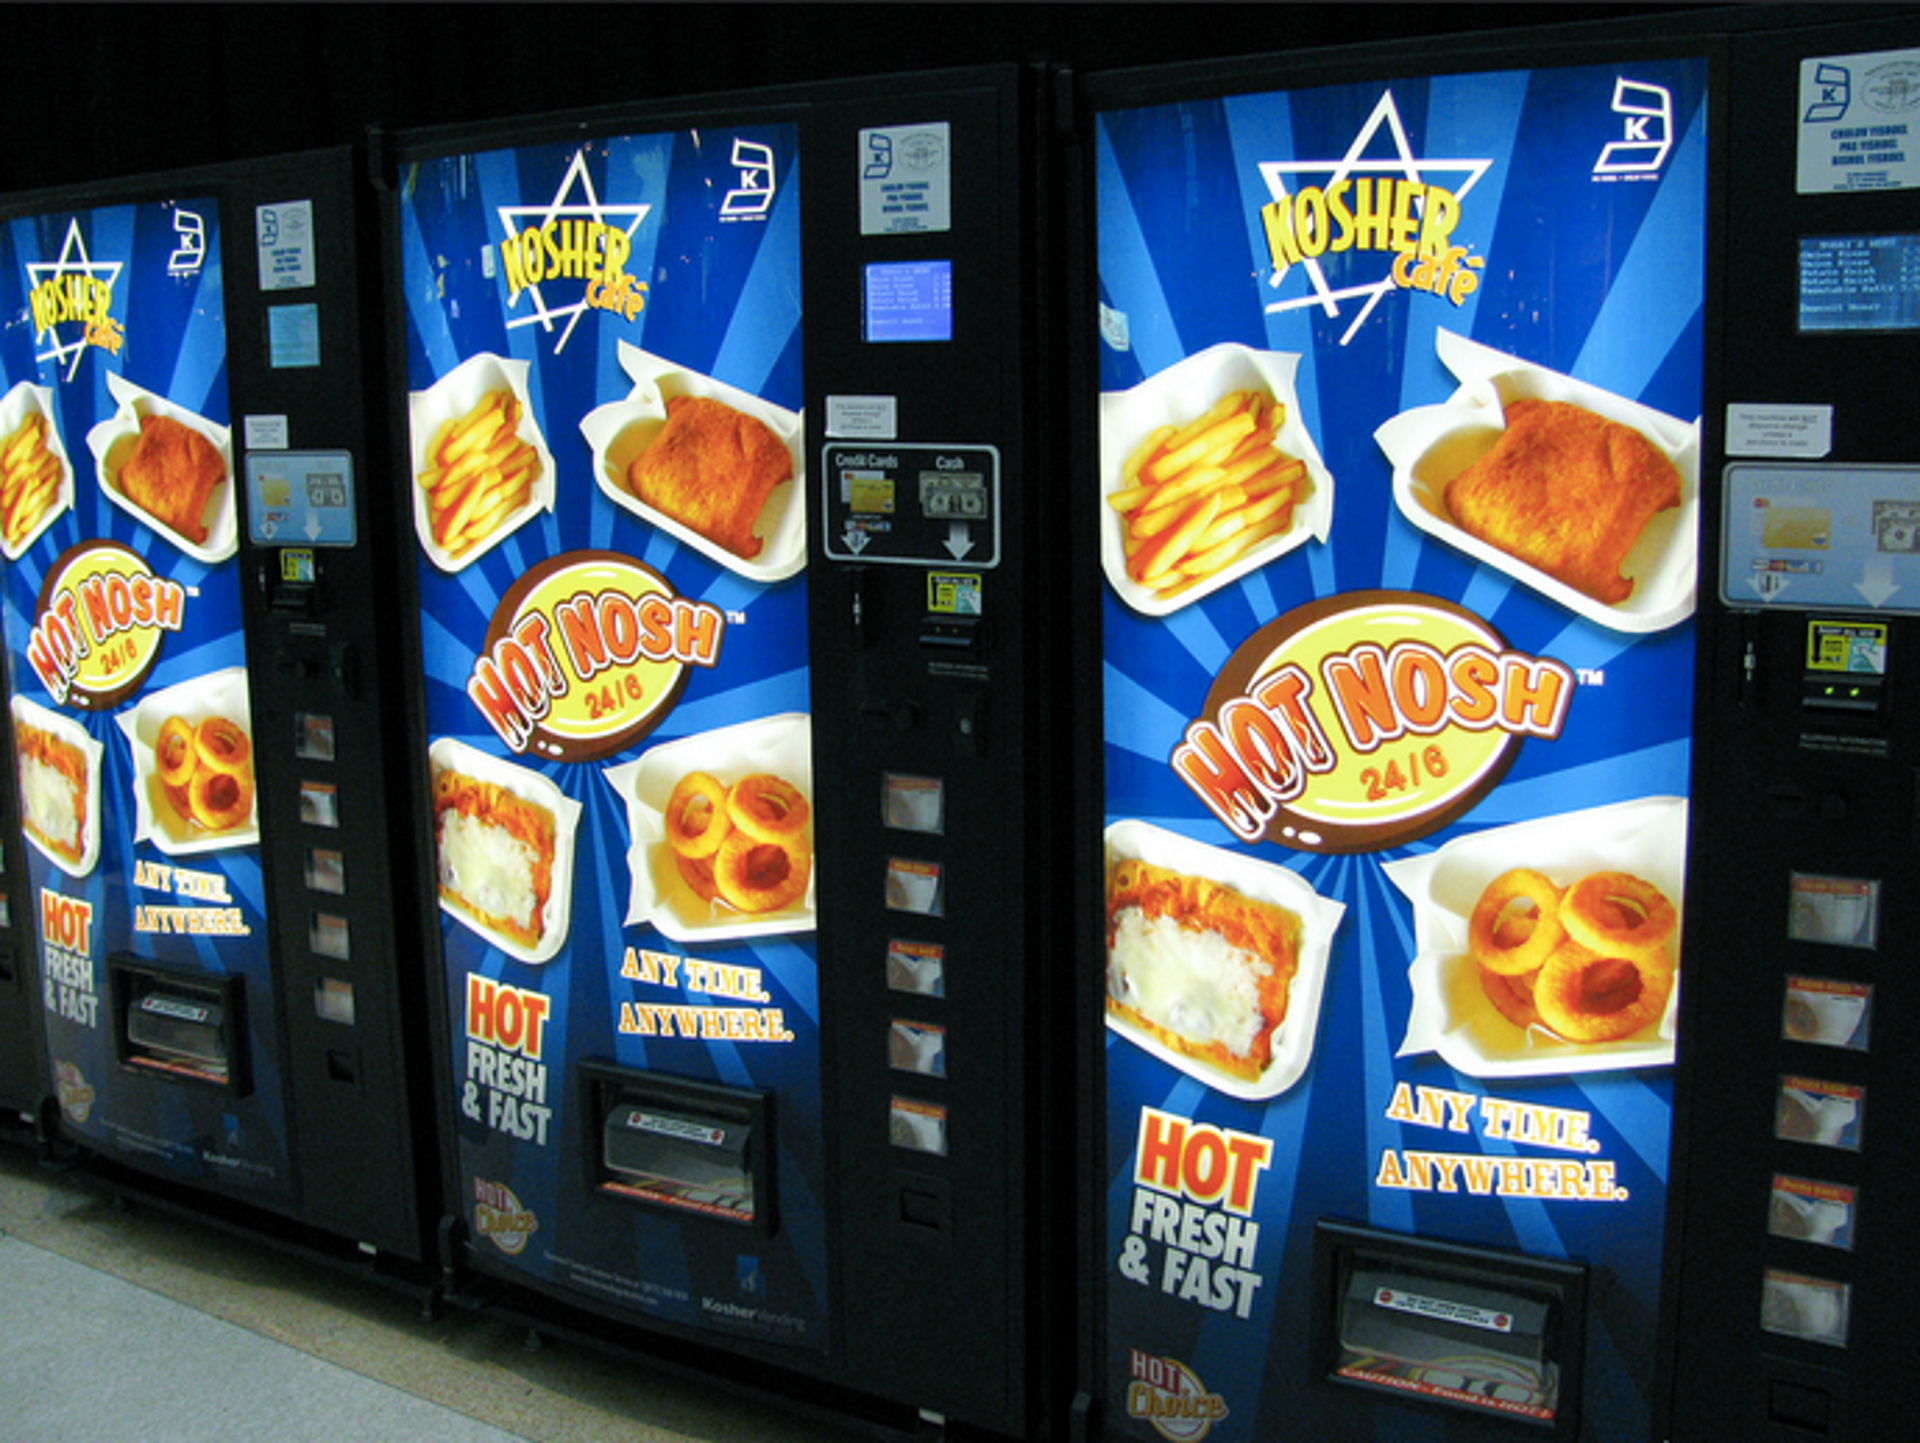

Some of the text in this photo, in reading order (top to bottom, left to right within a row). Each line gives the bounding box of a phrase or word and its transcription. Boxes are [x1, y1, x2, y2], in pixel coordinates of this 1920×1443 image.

[1261, 177, 1461, 272] KOSHER
[500, 219, 631, 296] KOSHER
[29, 274, 112, 334] KOSHER
[27, 570, 185, 705] HOT NOSH
[467, 610, 568, 753] HOT
[554, 590, 725, 682] NOSH
[584, 673, 644, 720] 24/6
[1171, 664, 1337, 841] HOT
[1322, 642, 1571, 750] NOSH
[1360, 744, 1449, 801] 24/6
[133, 860, 172, 893] ANY
[41, 887, 93, 958] HOT
[133, 905, 251, 936] ANYWHERE.
[44, 946, 94, 993] FRESH
[620, 946, 772, 1004] ANY TIME.
[59, 984, 98, 1029] FAST
[466, 972, 551, 1061] HOT
[618, 1002, 796, 1042] ANYWHERE.
[467, 1042, 548, 1105] FRESH
[461, 1081, 551, 1146] & FAST
[1386, 1080, 1601, 1154] ANY TIME.
[1134, 1105, 1275, 1218] HOT
[1376, 1150, 1629, 1201] ANYWHERE.
[1131, 1187, 1260, 1270] FRESH
[1118, 1236, 1263, 1320] & FAST
[1131, 1348, 1180, 1392] HOT
[1341, 1368, 1420, 1391] CAUTION
[1128, 1381, 1229, 1421] Choice
